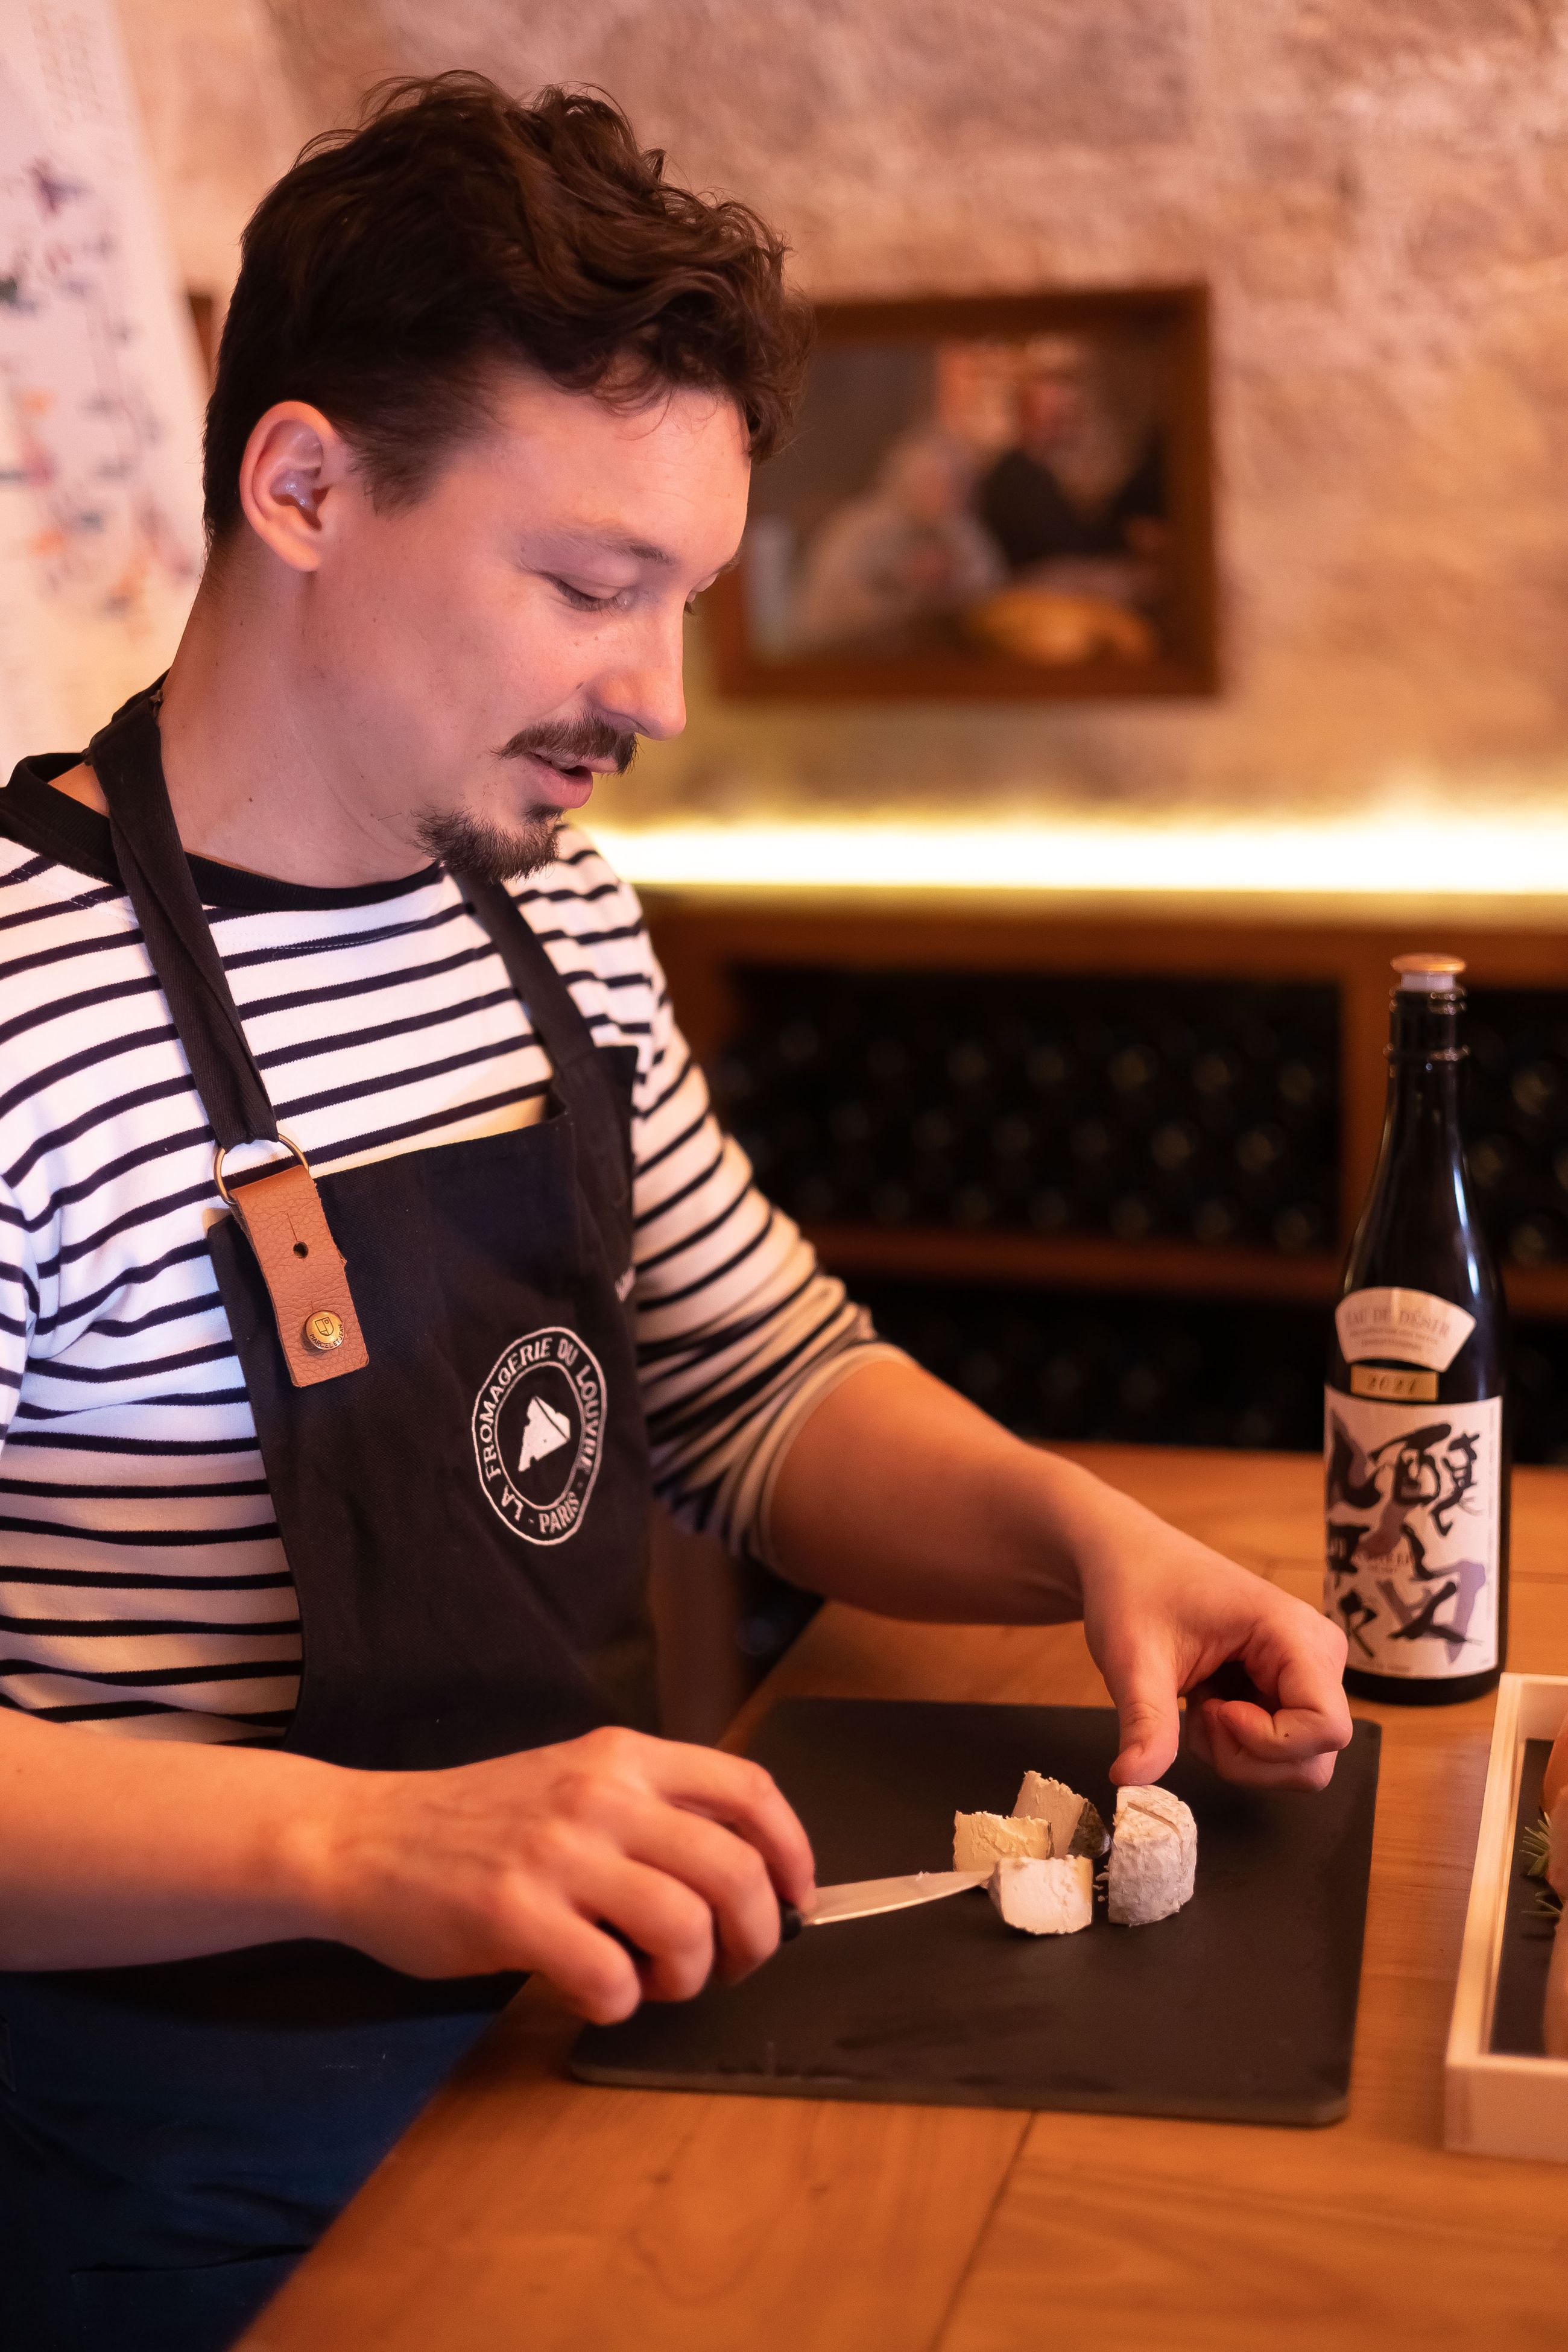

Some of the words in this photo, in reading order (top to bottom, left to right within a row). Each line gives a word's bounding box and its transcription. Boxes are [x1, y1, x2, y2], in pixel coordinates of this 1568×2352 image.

[309, 1333, 333, 1348] MARCEL
[333, 1338, 340, 1347] ET
[557, 1338, 578, 1367] DU
[479, 1337, 553, 1482] FROMAGERIE
[501, 1484, 523, 1522] LA
[539, 1491, 580, 1534] PARIS
